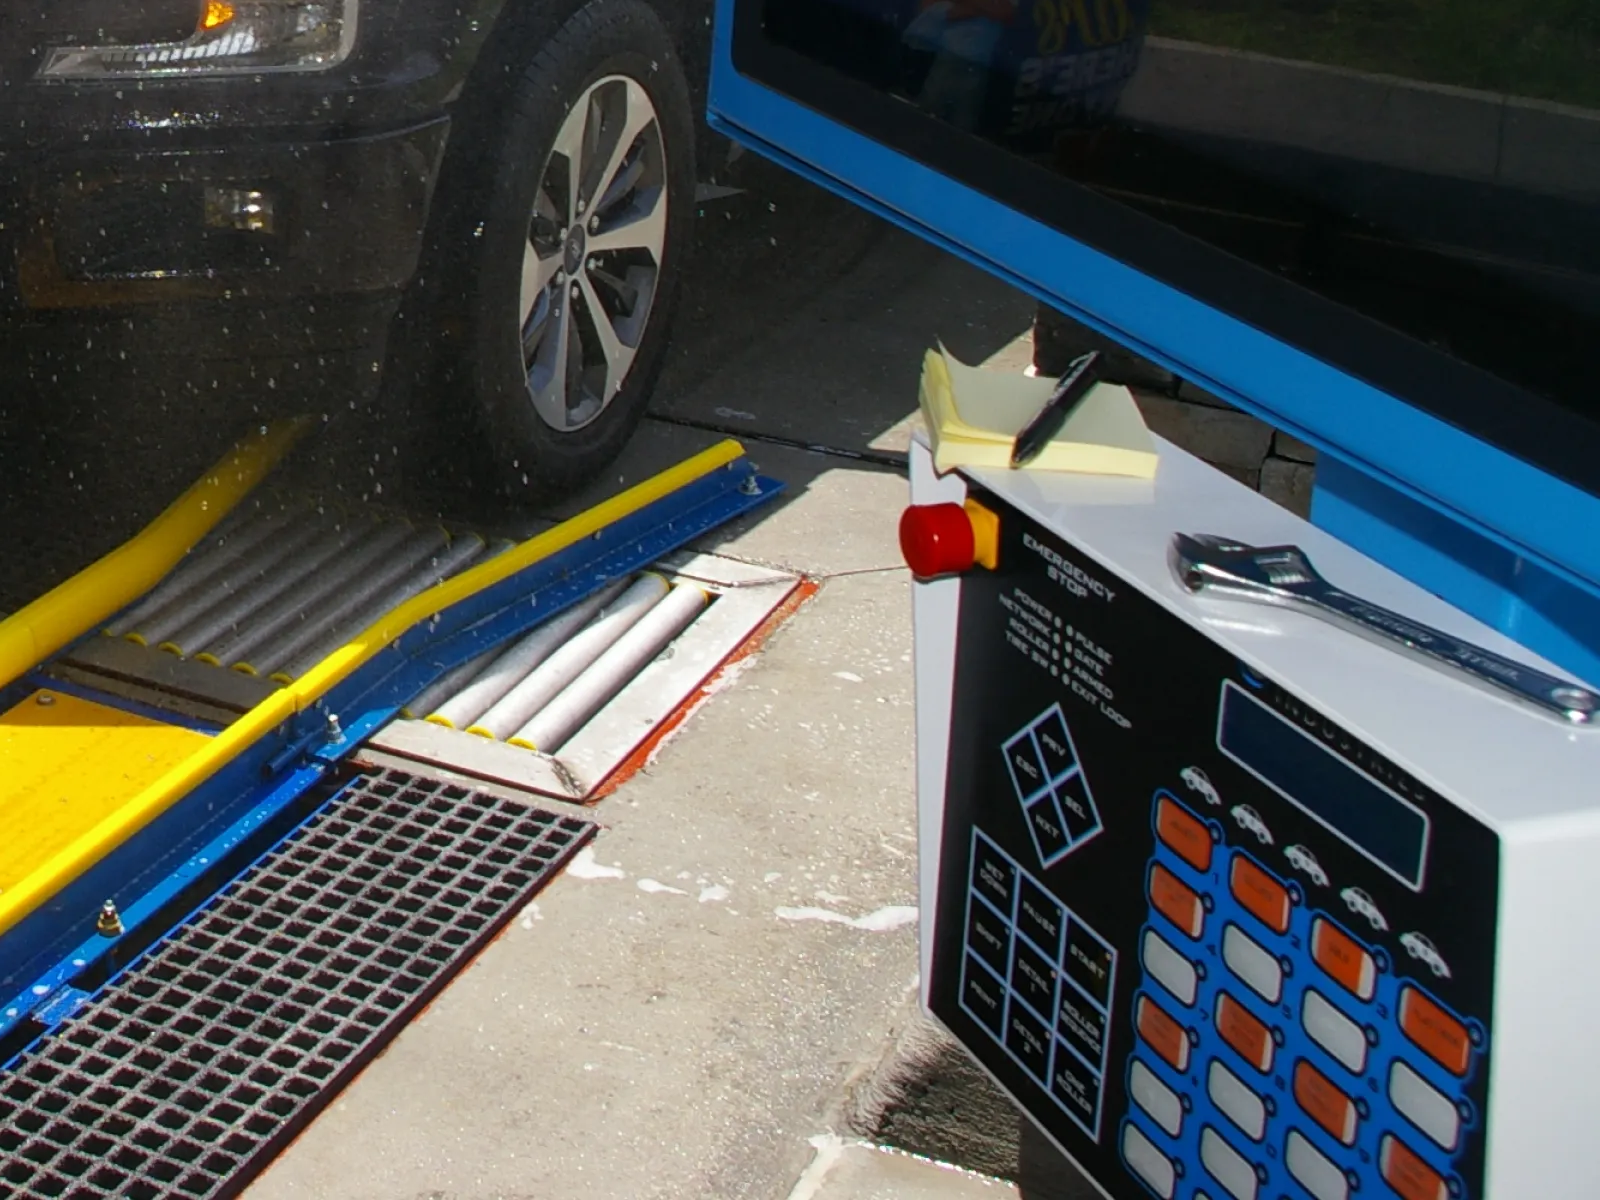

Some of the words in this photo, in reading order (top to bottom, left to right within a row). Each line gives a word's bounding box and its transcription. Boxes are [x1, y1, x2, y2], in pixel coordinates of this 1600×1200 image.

[1023, 532, 1116, 602] EMERGENCY
[1047, 564, 1089, 598] STOP
[999, 593, 1051, 638] NETWORK
[1014, 587, 1053, 621] POWER
[1009, 617, 1050, 653] ROLLER
[1074, 631, 1113, 665] PULSE
[1073, 648, 1104, 676] GATE
[1072, 665, 1114, 700] ARMED
[1071, 680, 1099, 705] EXIT
[1100, 701, 1132, 728] LOOP
[1015, 754, 1039, 779] ESC
[1022, 900, 1057, 936] PAUSE
[1070, 943, 1106, 979] START
[1063, 999, 1101, 1039] ROLLER
